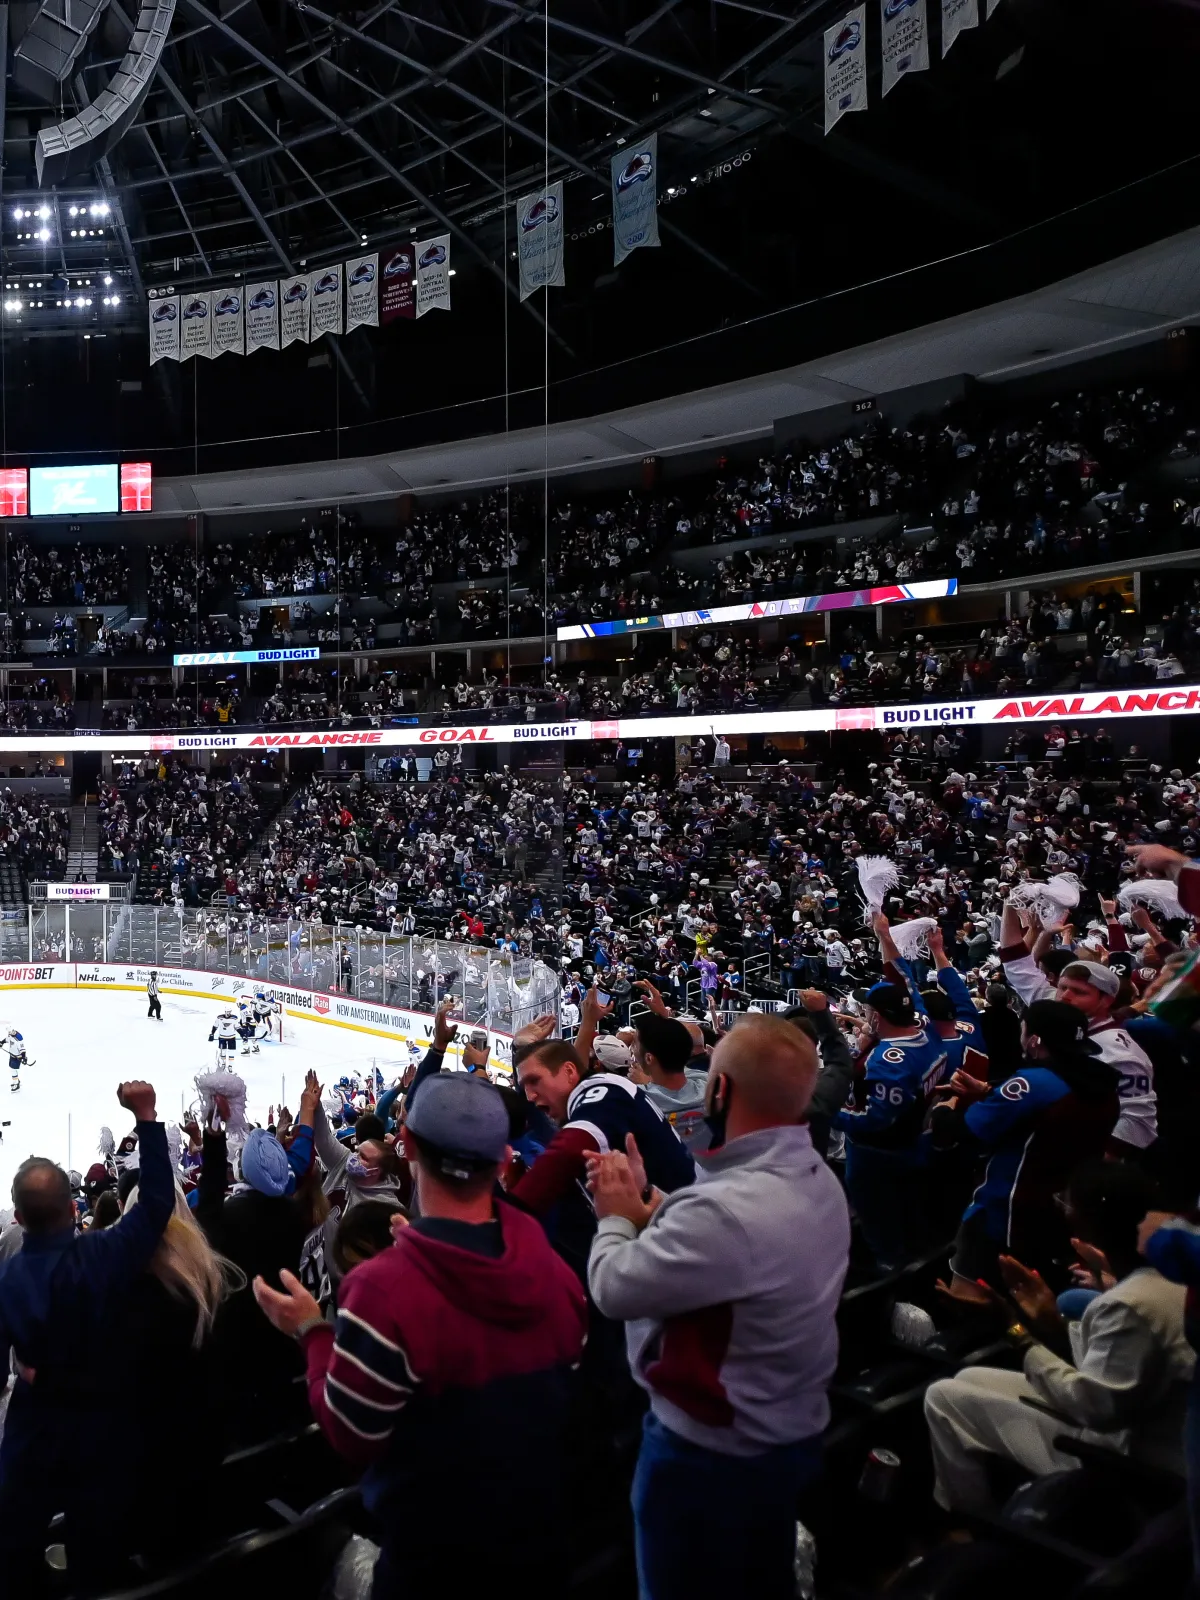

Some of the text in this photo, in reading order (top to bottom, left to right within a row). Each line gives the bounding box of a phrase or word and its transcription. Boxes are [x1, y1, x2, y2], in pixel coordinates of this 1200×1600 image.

[882, 25, 924, 55] CONFERENCE
[885, 35, 923, 62] CHAMPIONS
[826, 65, 864, 94] CONFERENCE
[830, 61, 860, 82] WESTERN
[828, 75, 863, 100] CHAMPIONS
[855, 401, 872, 412] 362
[177, 648, 317, 665] GOAL BUD LIGHT
[883, 708, 920, 723] BUD
[923, 706, 976, 722] LIGHT
[178, 726, 577, 748] BUD LIGHT AVALANCHE GOAL BUD LIGHT
[170, 978, 193, 987] Children
[315, 996, 330, 1009] Rate
[336, 1004, 411, 1031] NEW AMSTERDAM VODKA
[875, 1082, 903, 1106] 96
